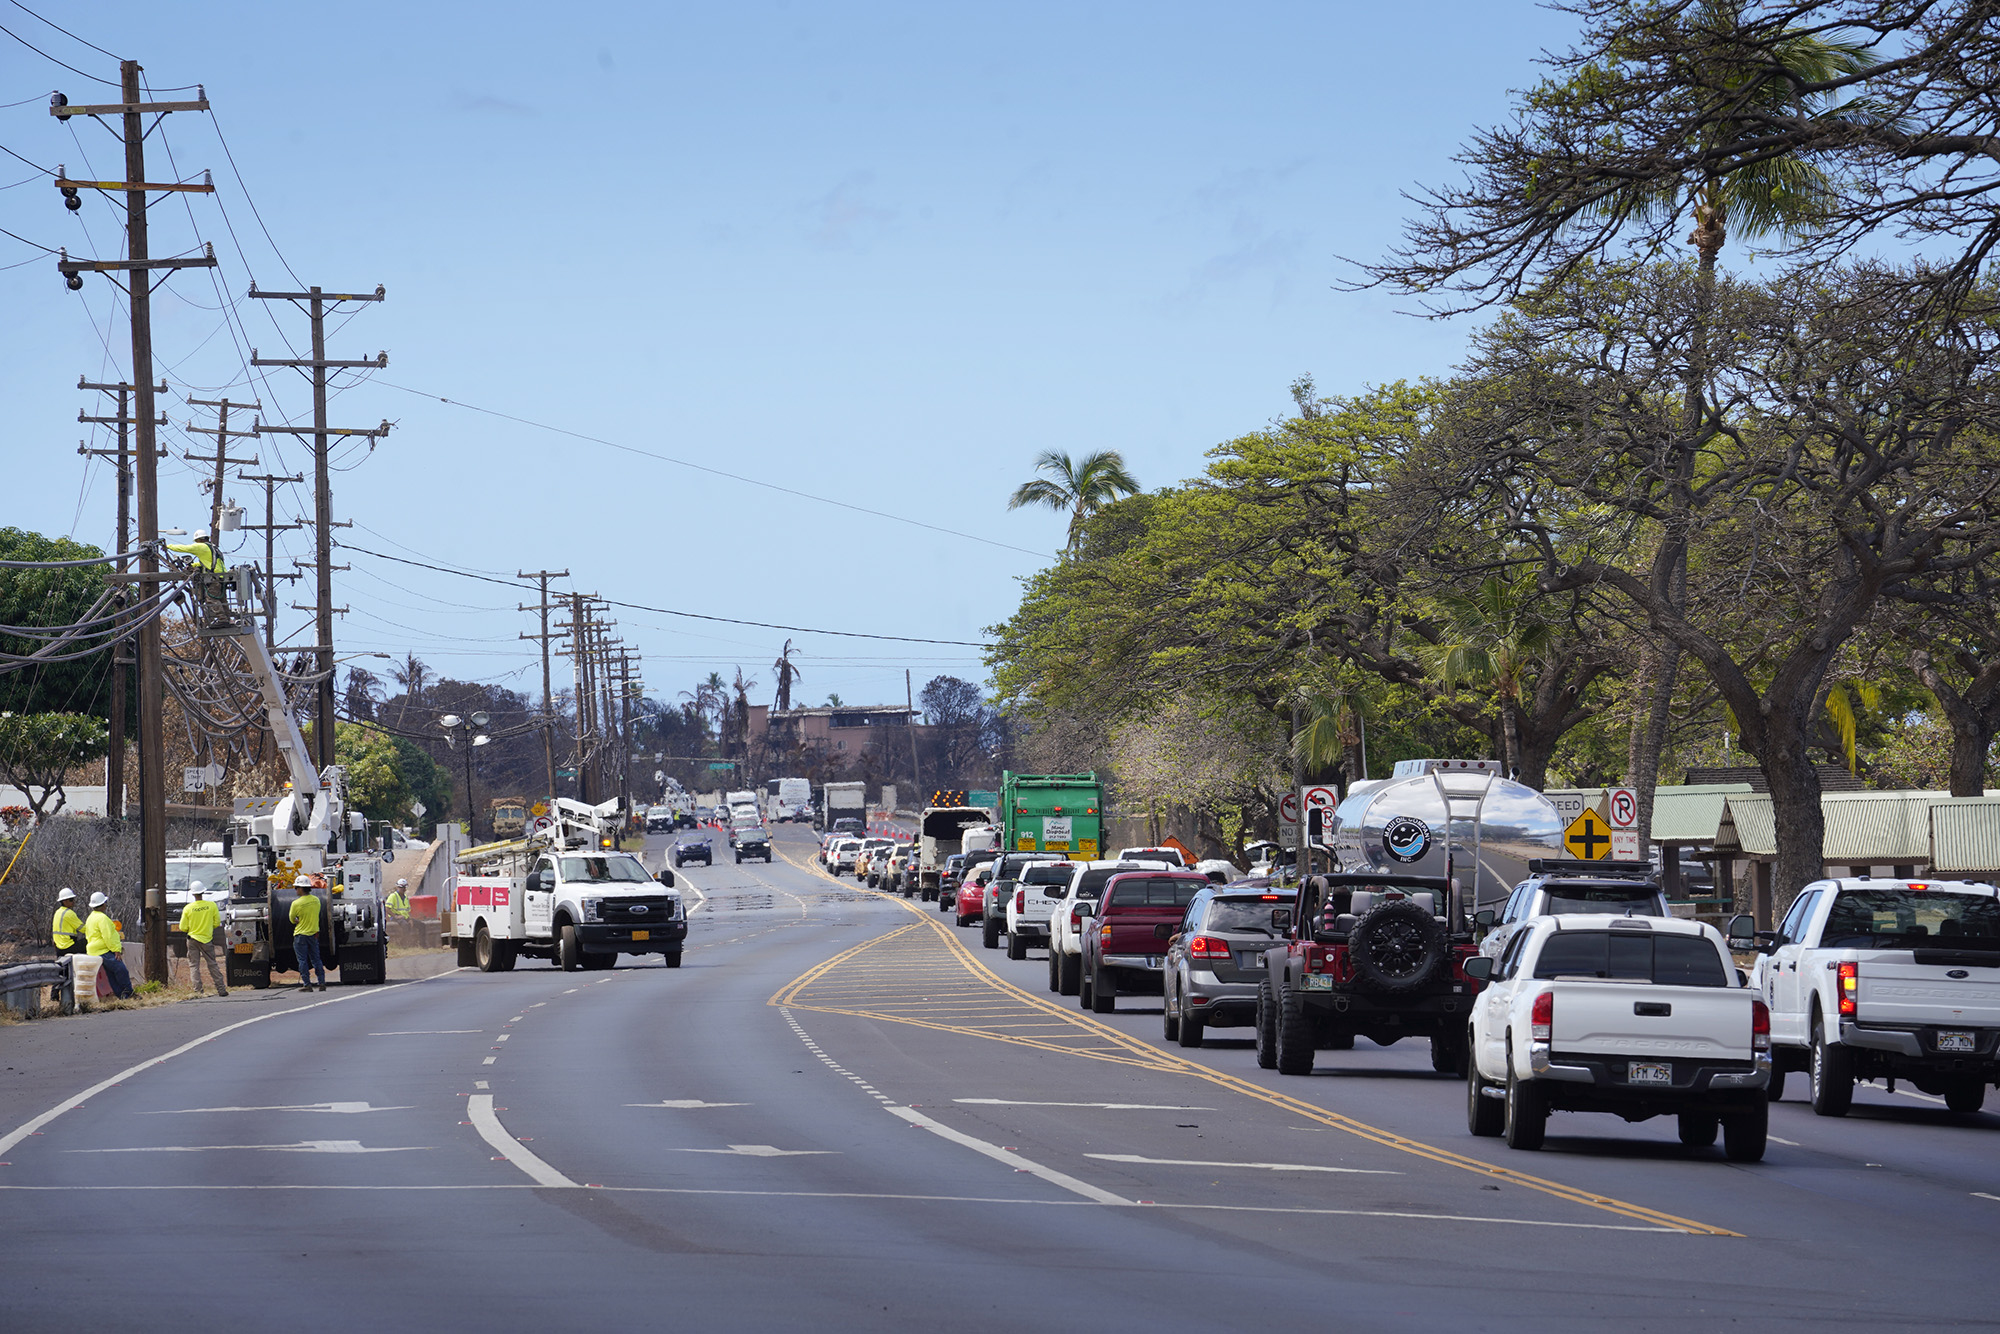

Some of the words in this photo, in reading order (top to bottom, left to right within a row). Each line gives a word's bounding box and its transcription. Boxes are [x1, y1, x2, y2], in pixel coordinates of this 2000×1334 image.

[1384, 822, 1397, 838] MAUI
[1408, 817, 1431, 842] COMPANY
[1614, 836, 1624, 844] ANY
[1626, 836, 1636, 844] TIME
[1595, 1038, 1711, 1051] TACOMA
[1939, 1035, 1955, 1047] 555
[1653, 1068, 1670, 1080] 455
